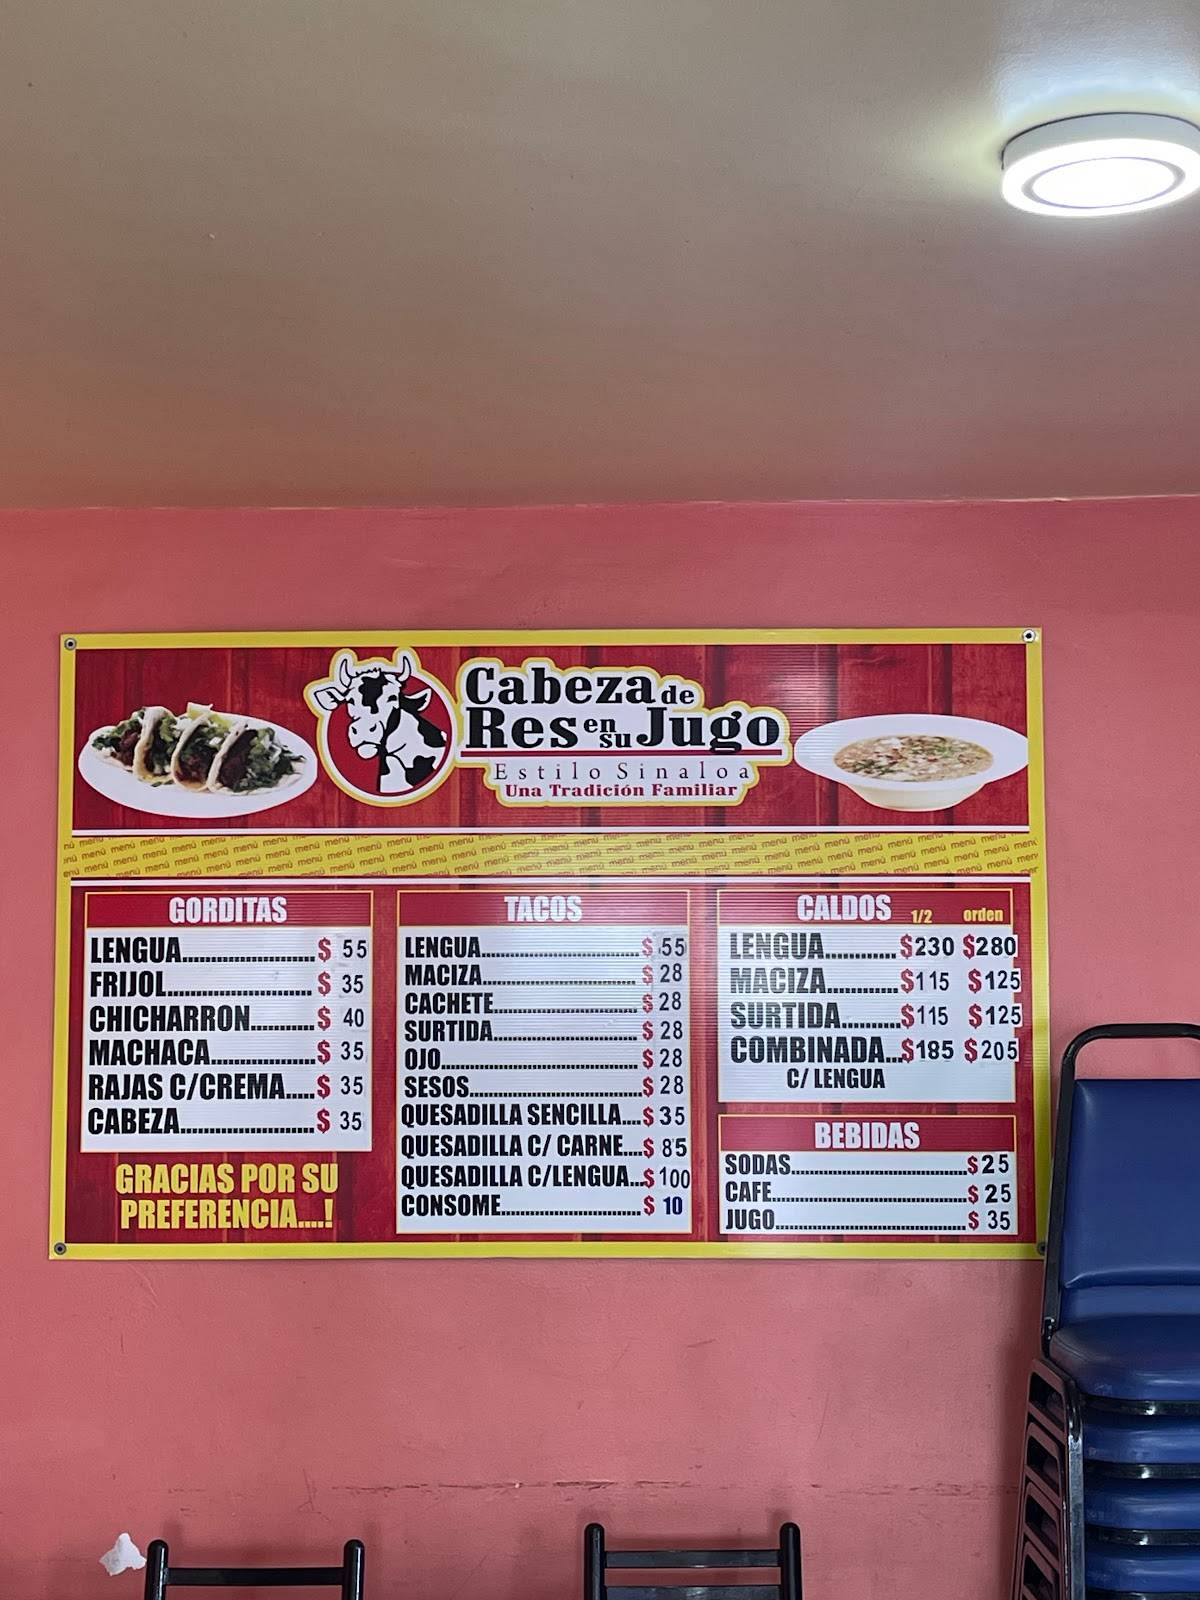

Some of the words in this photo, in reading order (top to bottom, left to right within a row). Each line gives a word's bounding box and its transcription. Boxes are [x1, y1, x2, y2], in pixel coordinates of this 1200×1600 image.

[466, 667, 656, 705] Cabeza
[661, 685, 695, 704] de
[466, 707, 579, 749] Res
[584, 718, 616, 733] en
[600, 733, 632, 748] su
[636, 707, 780, 754] Jugo
[494, 762, 601, 780] Estilo
[618, 761, 750, 780] Sinaloa
[505, 784, 542, 798] Una
[550, 784, 645, 797] Tradición
[652, 784, 738, 796] Familiar
[169, 897, 287, 923] GORDITAS
[504, 896, 583, 922] TACOS
[797, 894, 892, 921] CALDOS
[912, 910, 933, 924] 1/2
[963, 908, 1003, 922] orden
[91, 937, 182, 963] LENGUA
[405, 937, 481, 958] LENGUA
[730, 933, 824, 960] LENGUA
[91, 971, 166, 997] FRIJOL
[405, 964, 482, 986] MACIZA
[730, 968, 826, 994] MACIZA
[405, 992, 494, 1014] CACHETE
[730, 1002, 841, 1029] SURTIDA
[90, 1005, 250, 1032] CHICHARRON
[405, 1020, 493, 1042] SURTIDA
[89, 1039, 210, 1066] MACHACA
[405, 1048, 441, 1070] OJO
[731, 1036, 886, 1064] COMBINADA
[89, 1074, 163, 1100] RAJAS
[172, 1073, 285, 1100] C/CREMA
[405, 1076, 469, 1098] SESOS
[814, 1068, 886, 1089] LENGUA
[88, 1108, 180, 1135] CABEZA
[401, 1103, 522, 1128] QUESADILLA
[527, 1103, 621, 1126] SENCILLA
[401, 1135, 523, 1159] QUESADILLA
[557, 1135, 623, 1157] CARNE
[814, 1122, 920, 1149] BEBIDAS
[401, 1165, 523, 1190] QUESADILLA
[528, 1165, 629, 1188] C/LENGUA
[725, 1154, 791, 1176] SODAS
[116, 1163, 237, 1194] GRACIAS
[241, 1163, 295, 1193] POR
[302, 1163, 339, 1193] SU
[725, 1181, 771, 1203] CAFE
[401, 1194, 501, 1217] CONSOME
[725, 1209, 775, 1230] JUGO
